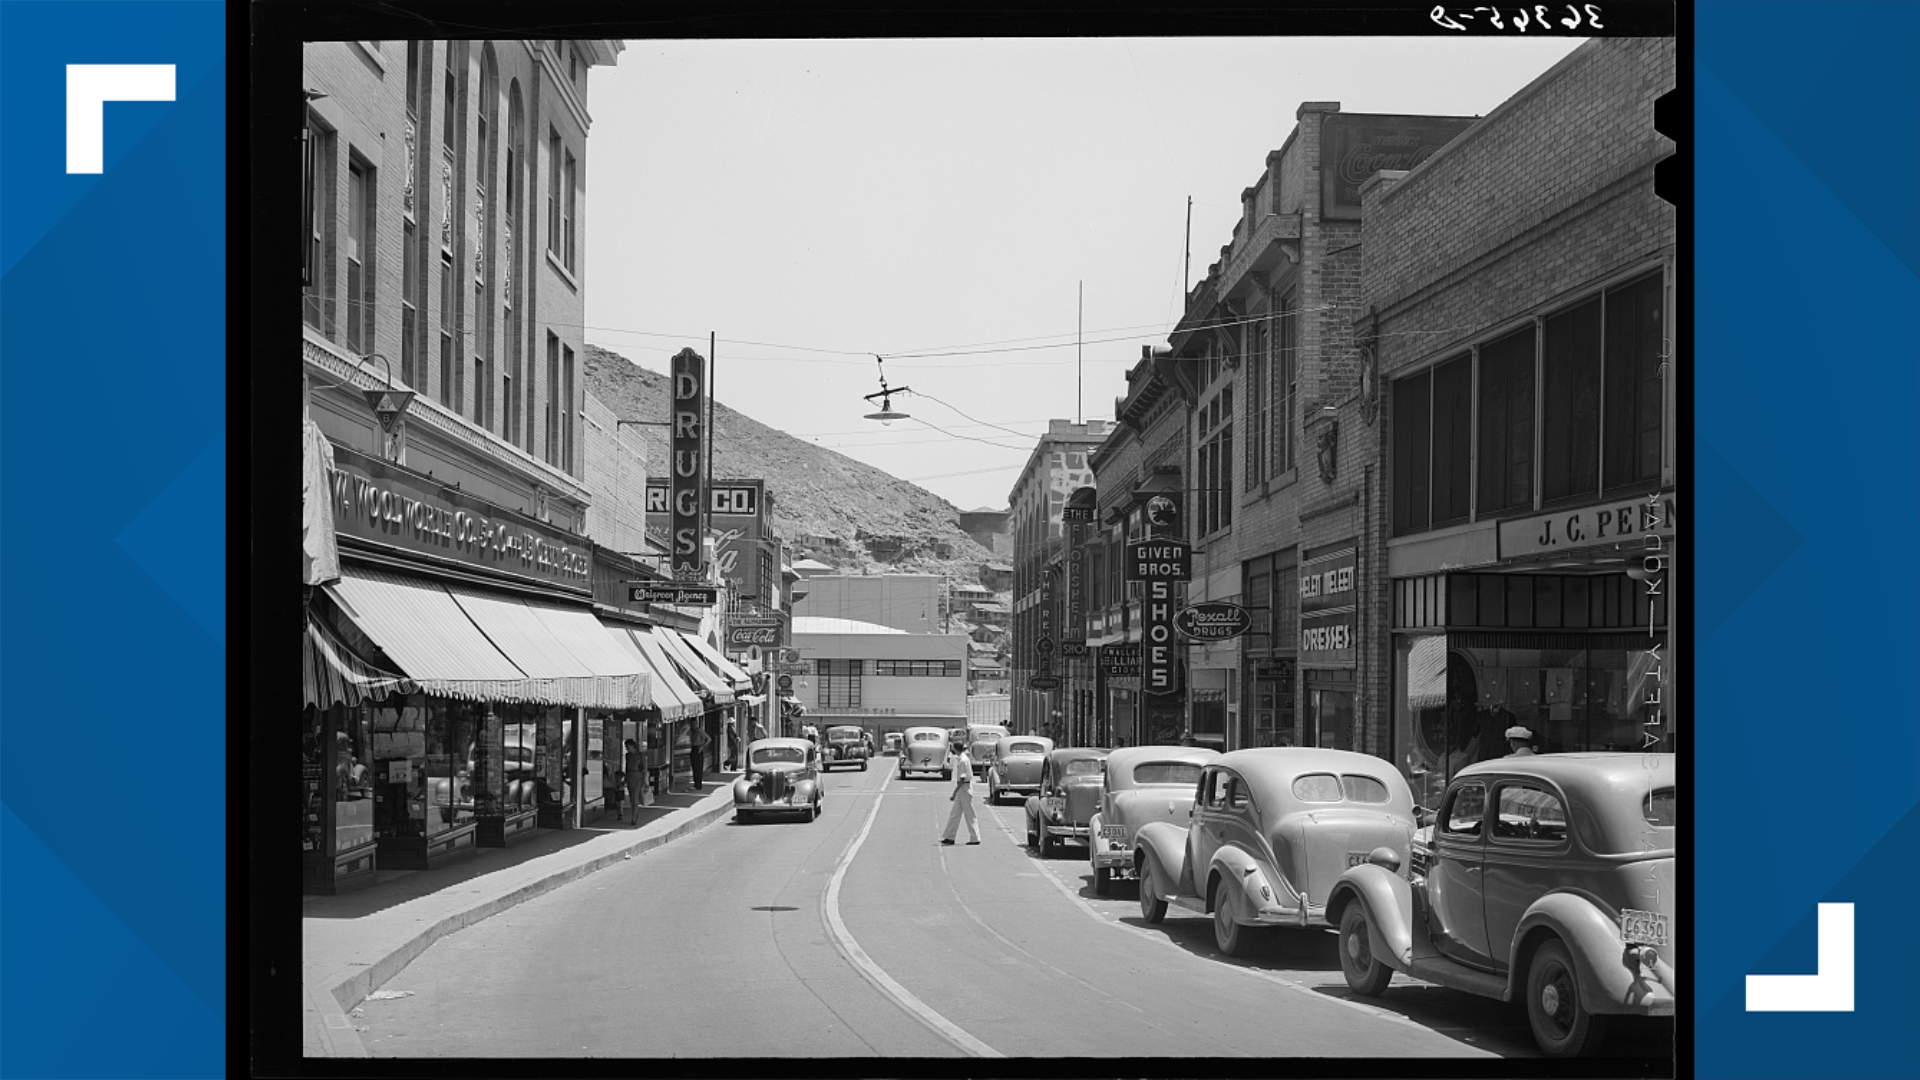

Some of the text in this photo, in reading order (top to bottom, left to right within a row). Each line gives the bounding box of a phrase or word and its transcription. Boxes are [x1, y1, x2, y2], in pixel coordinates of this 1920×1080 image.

[675, 372, 699, 555] DRUGS
[711, 489, 754, 513] CO.
[1538, 520, 1556, 546] J.
[1566, 514, 1585, 543] C.
[1137, 547, 1182, 560] GIVEN
[1138, 563, 1185, 577] BROS.
[1186, 608, 1242, 626] Rexall
[1151, 581, 1169, 687] SHOES
[1194, 627, 1233, 636] DRUGS
[1303, 625, 1349, 651] DRESSES
[1626, 917, 1663, 937] C6350
